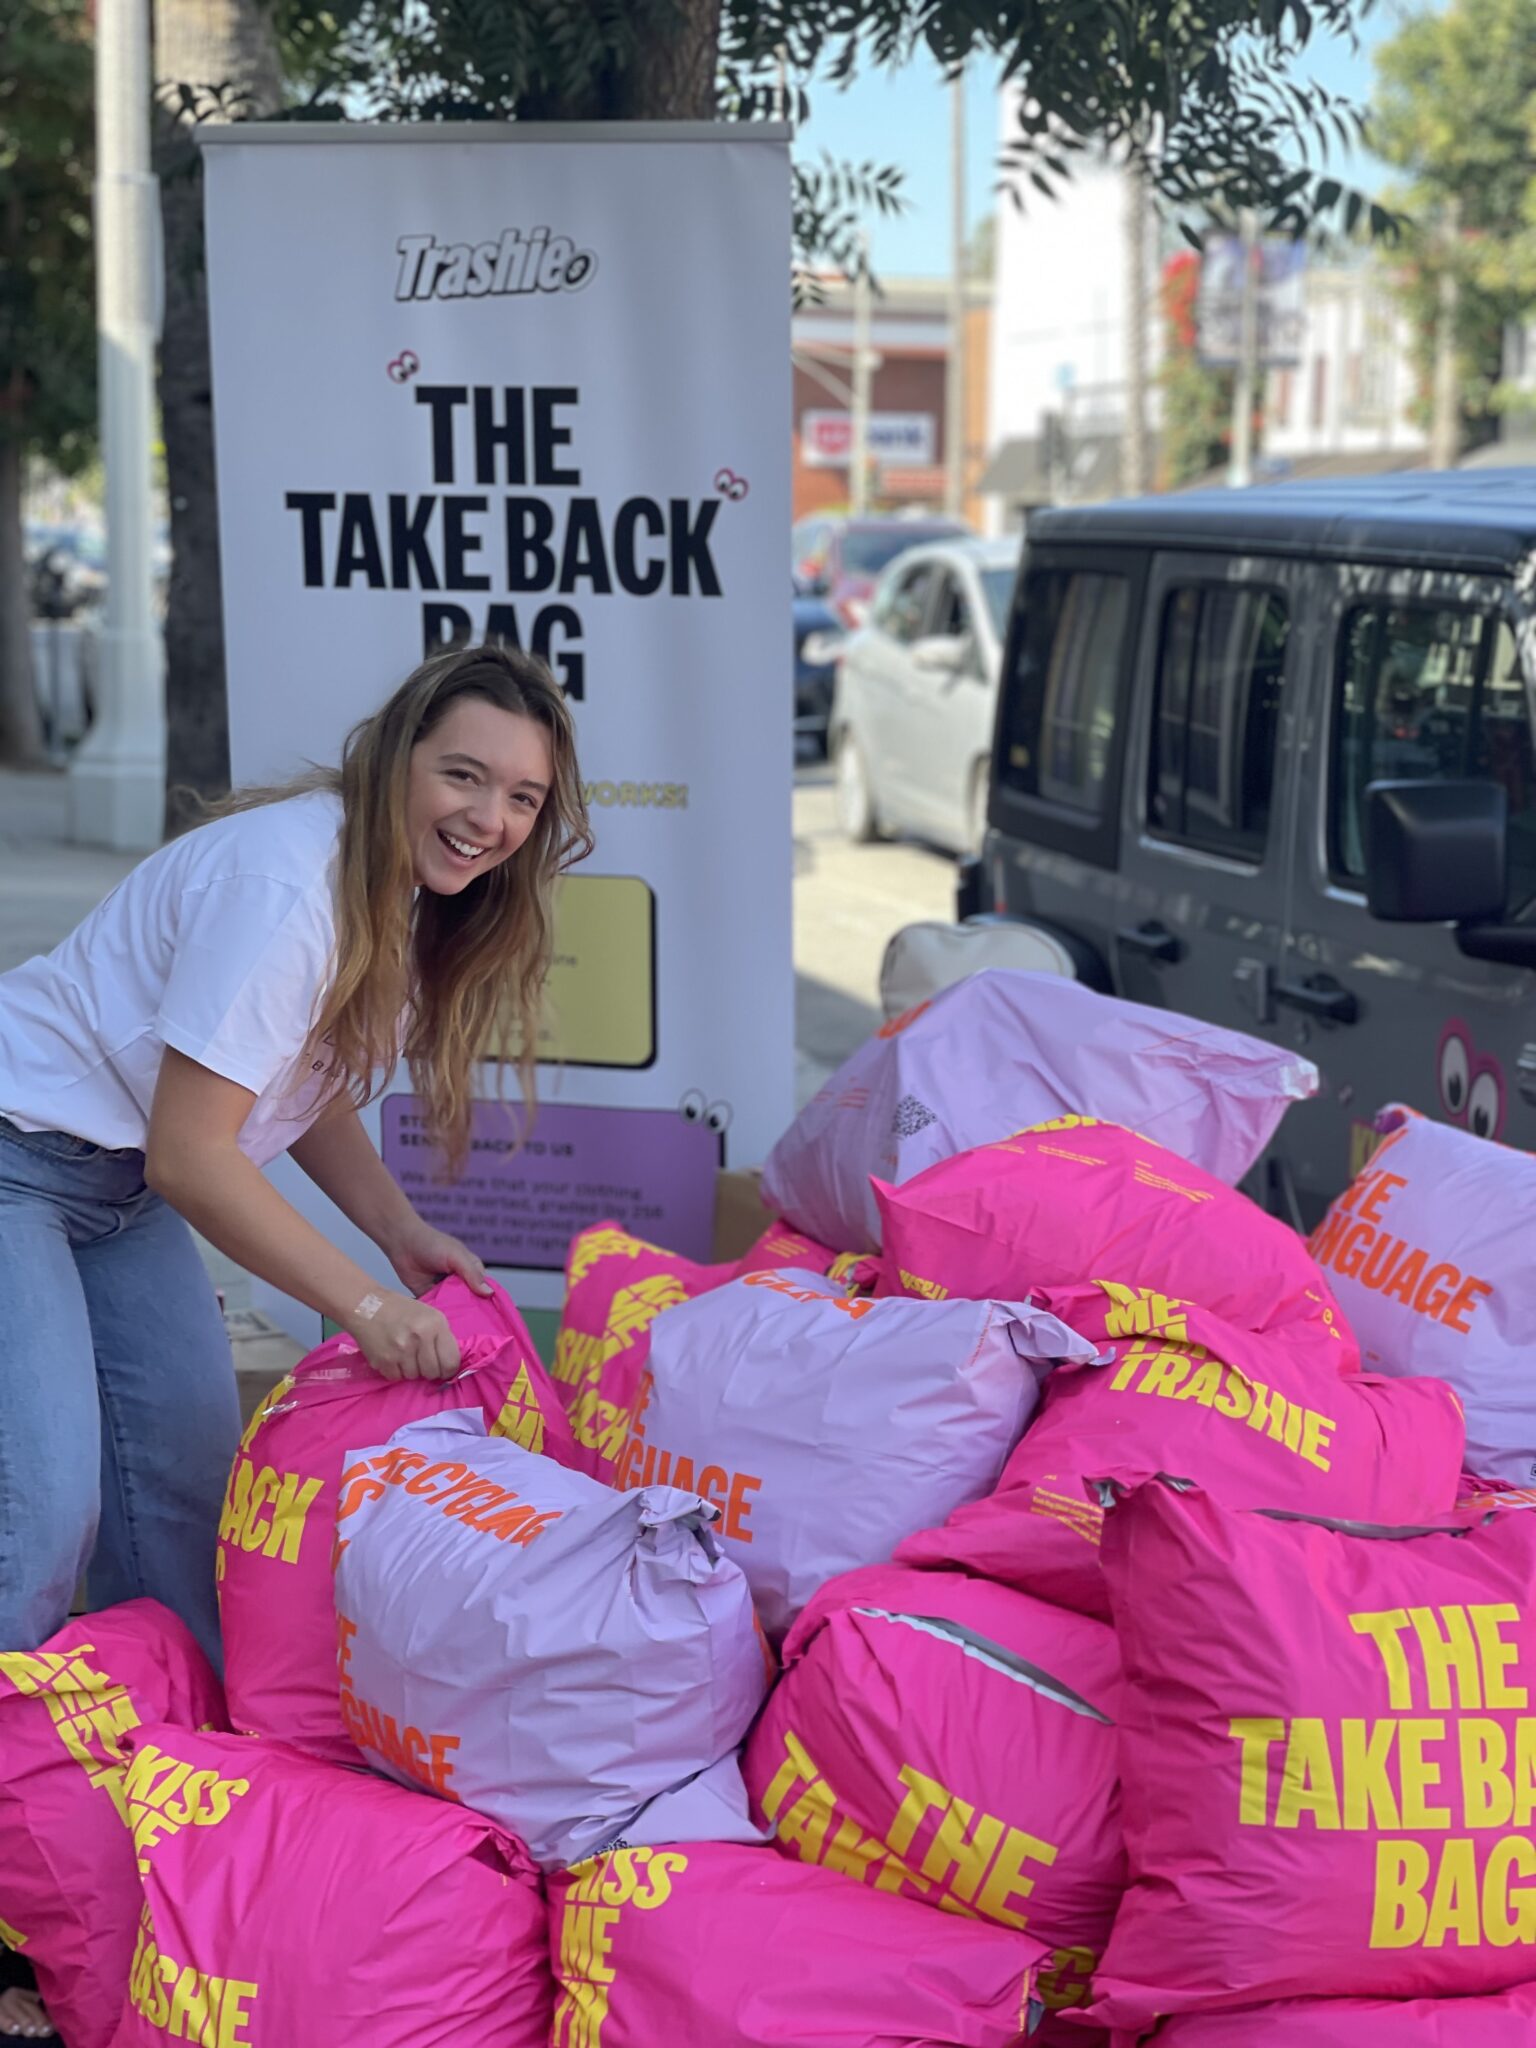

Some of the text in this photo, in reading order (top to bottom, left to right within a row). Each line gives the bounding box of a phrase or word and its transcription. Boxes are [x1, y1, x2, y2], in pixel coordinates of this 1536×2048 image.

[395, 225, 576, 301] Trashie
[415, 386, 581, 487] THE
[285, 492, 723, 598] TAKE BACK
[1108, 1351, 1337, 1473] TRASHIE
[217, 1457, 325, 1566] ACK
[1349, 1603, 1528, 1710] THE
[124, 1744, 250, 1827] KISS
[1229, 1718, 1451, 1830] TAKE
[886, 1763, 1059, 1930] THE
[1369, 1836, 1536, 1949] BAG
